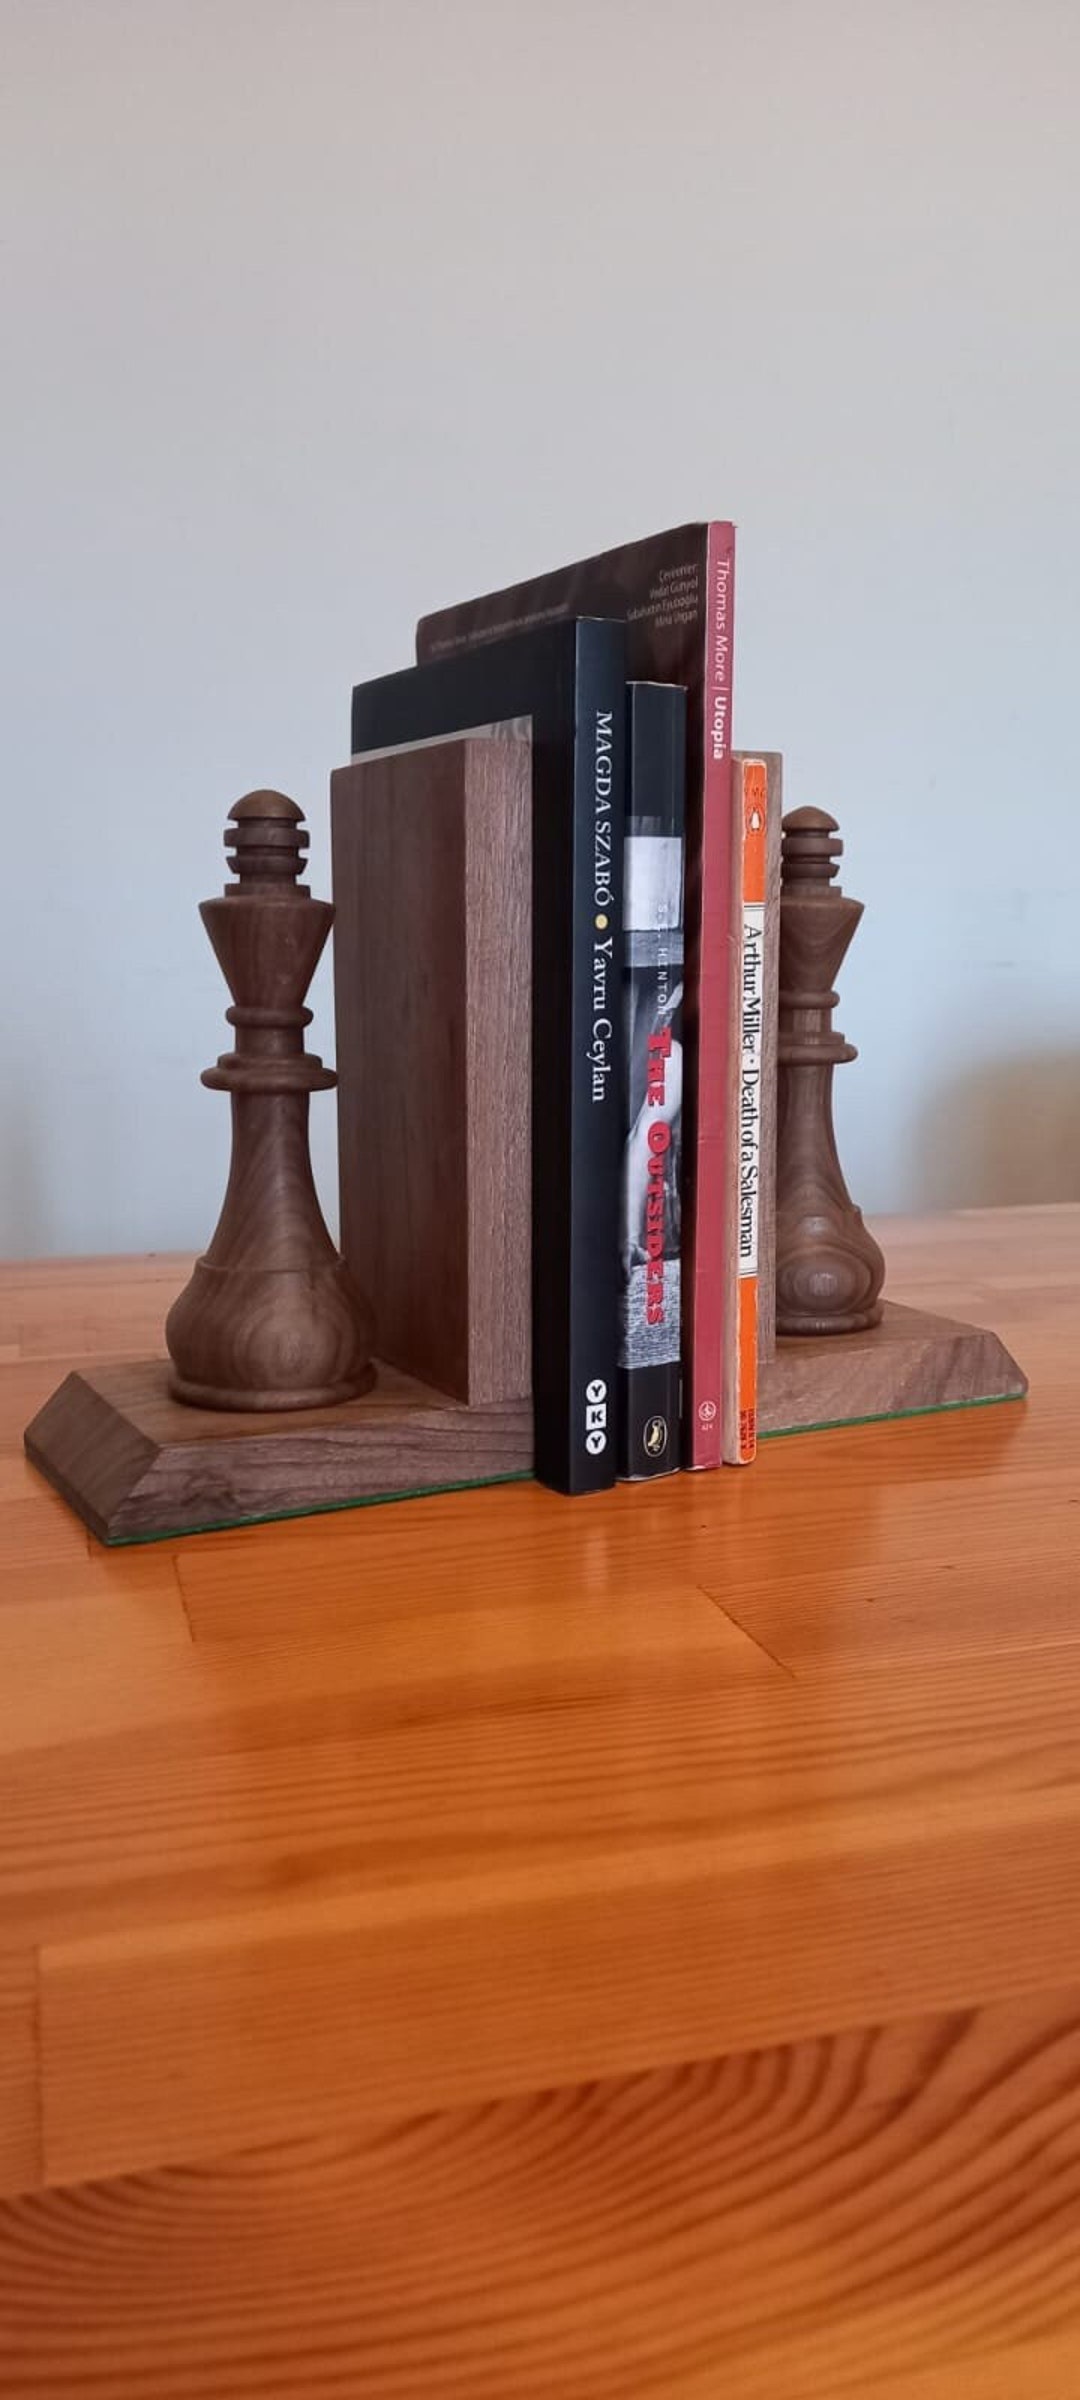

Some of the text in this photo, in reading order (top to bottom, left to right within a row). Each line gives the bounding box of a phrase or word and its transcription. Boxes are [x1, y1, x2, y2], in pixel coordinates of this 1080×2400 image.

[710, 559, 730, 760] Thomas More Utopia
[586, 711, 614, 1103] MAGDA SZABÓ Yavru Ceylan
[657, 947, 669, 1016] HINTON
[647, 1026, 672, 1325] THE OUTSIDERS
[740, 924, 762, 1258] Arthur Miller Death of a Salesman
[589, 1382, 604, 1452] YKY
